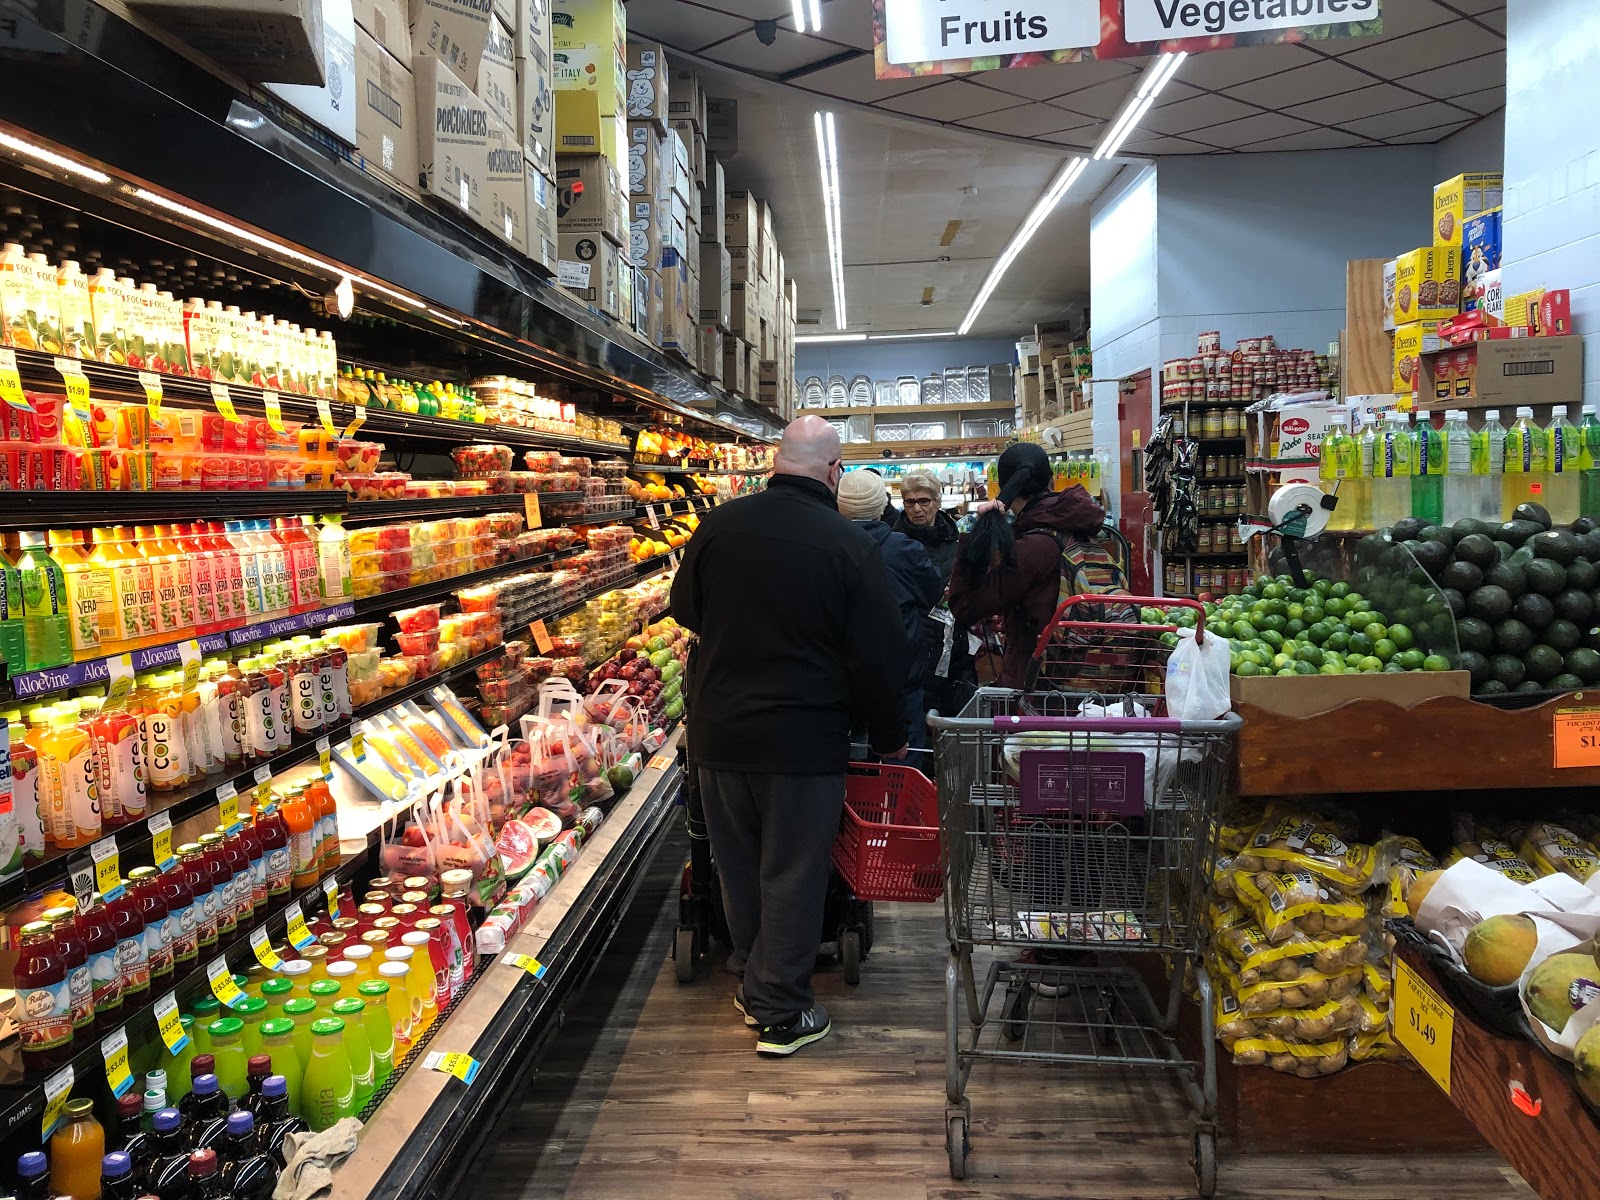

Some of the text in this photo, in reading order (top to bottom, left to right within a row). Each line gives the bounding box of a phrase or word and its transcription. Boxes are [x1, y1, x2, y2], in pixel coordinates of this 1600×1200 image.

[941, 10, 1048, 47] Fruits
[561, 69, 581, 78] ITALY
[436, 105, 488, 136] POPCORNERS
[1436, 192, 1459, 210] Cheerios
[1424, 250, 1434, 279] Cheerios
[1445, 249, 1455, 278] Cheerios
[1396, 265, 1416, 281] Cheerios
[74, 279, 88, 289] FOC
[1487, 288, 1502, 303] COR
[1487, 301, 1502, 313] FLAKE
[1396, 337, 1418, 350] Cheerios
[68, 385, 85, 396] $1.99
[285, 560, 293, 570] LOE
[244, 576, 258, 589] VERA
[262, 573, 274, 585] VERA
[274, 572, 286, 584] VERA
[285, 570, 293, 581] ERA
[48, 568, 57, 612] Aloevine
[177, 584, 192, 598] VERA
[195, 582, 211, 596] VERA
[214, 580, 228, 592] VERA
[230, 578, 243, 590] VERA
[138, 591, 154, 605] VERA
[158, 588, 175, 601] VERA
[76, 600, 97, 615] VERA
[269, 619, 297, 635] Aloevine
[231, 627, 263, 645] Aloevine
[199, 637, 223, 652] oevine
[140, 647, 181, 667] Aloevine
[84, 663, 108, 681] Aloe
[18, 672, 71, 695] Aloevine
[299, 679, 315, 720] core
[321, 674, 335, 713] core
[262, 696, 276, 740] core
[153, 721, 170, 770] core
[131, 741, 145, 795] core
[84, 758, 100, 815] core
[222, 805, 236, 816] $1.99
[155, 837, 169, 849] $1.99
[100, 864, 116, 878] $1.99
[29, 990, 51, 1004] Ralph
[1407, 979, 1445, 1020] PAPAYA LARGE
[28, 1002, 57, 1018] Charlie's
[1420, 1002, 1428, 1015] MX
[1409, 1007, 1436, 1046] $1.49
[8, 1103, 33, 1127] PLUMS
